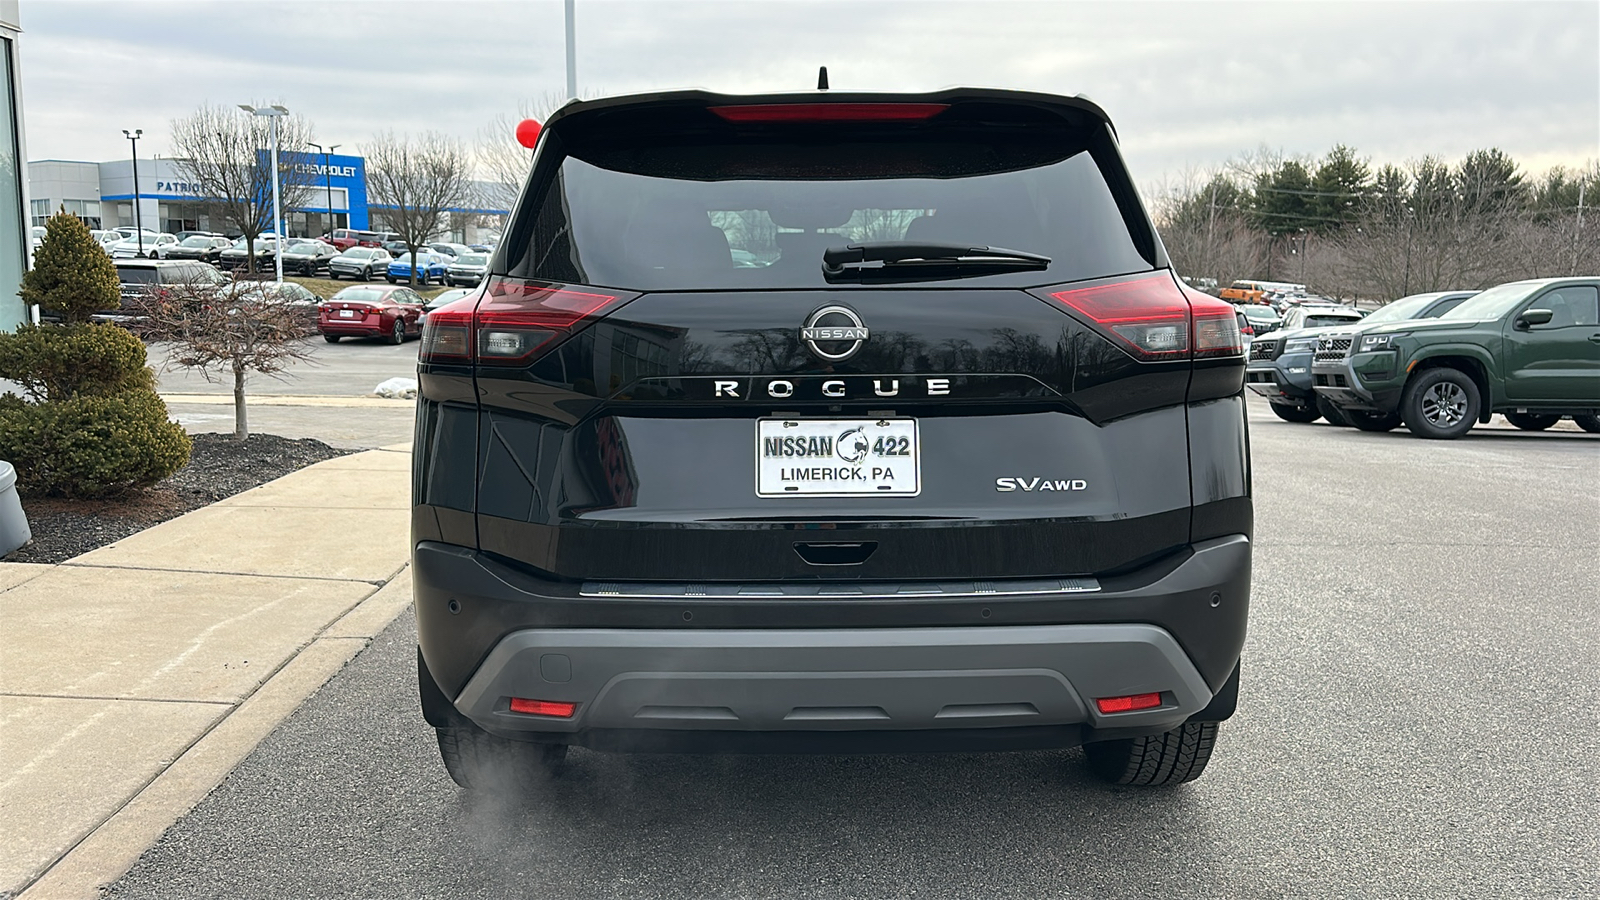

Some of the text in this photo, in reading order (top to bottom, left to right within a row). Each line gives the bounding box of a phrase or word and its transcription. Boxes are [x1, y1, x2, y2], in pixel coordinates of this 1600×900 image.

[295, 163, 356, 177] CHEVROLET
[803, 329, 868, 339] NISSAN
[714, 378, 950, 397] ROGUE
[764, 436, 911, 458] NISSAN 422
[780, 467, 895, 482] LIMERICK, PA
